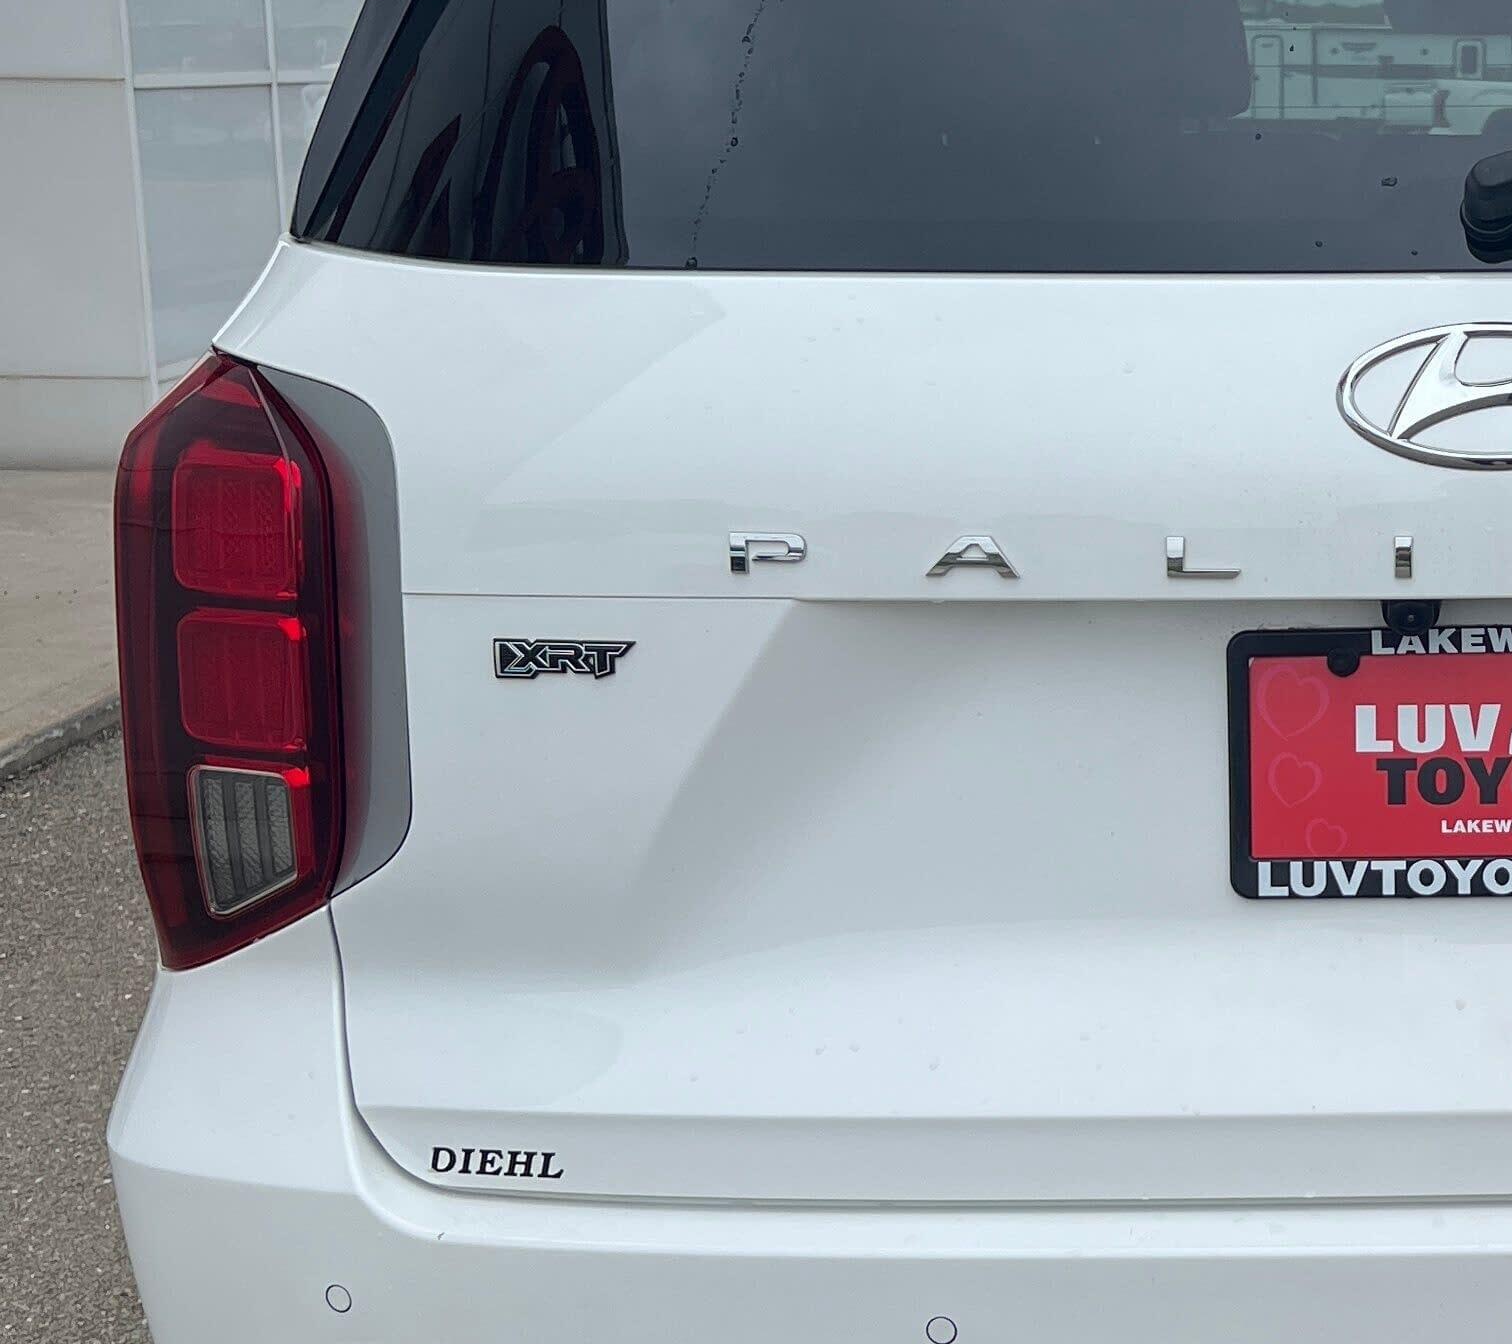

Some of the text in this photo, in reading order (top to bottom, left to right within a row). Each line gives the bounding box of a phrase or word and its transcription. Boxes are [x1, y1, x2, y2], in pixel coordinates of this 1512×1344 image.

[493, 637, 636, 679] XRT
[1355, 704, 1500, 753] LUV
[431, 1146, 564, 1179] DIEHL
